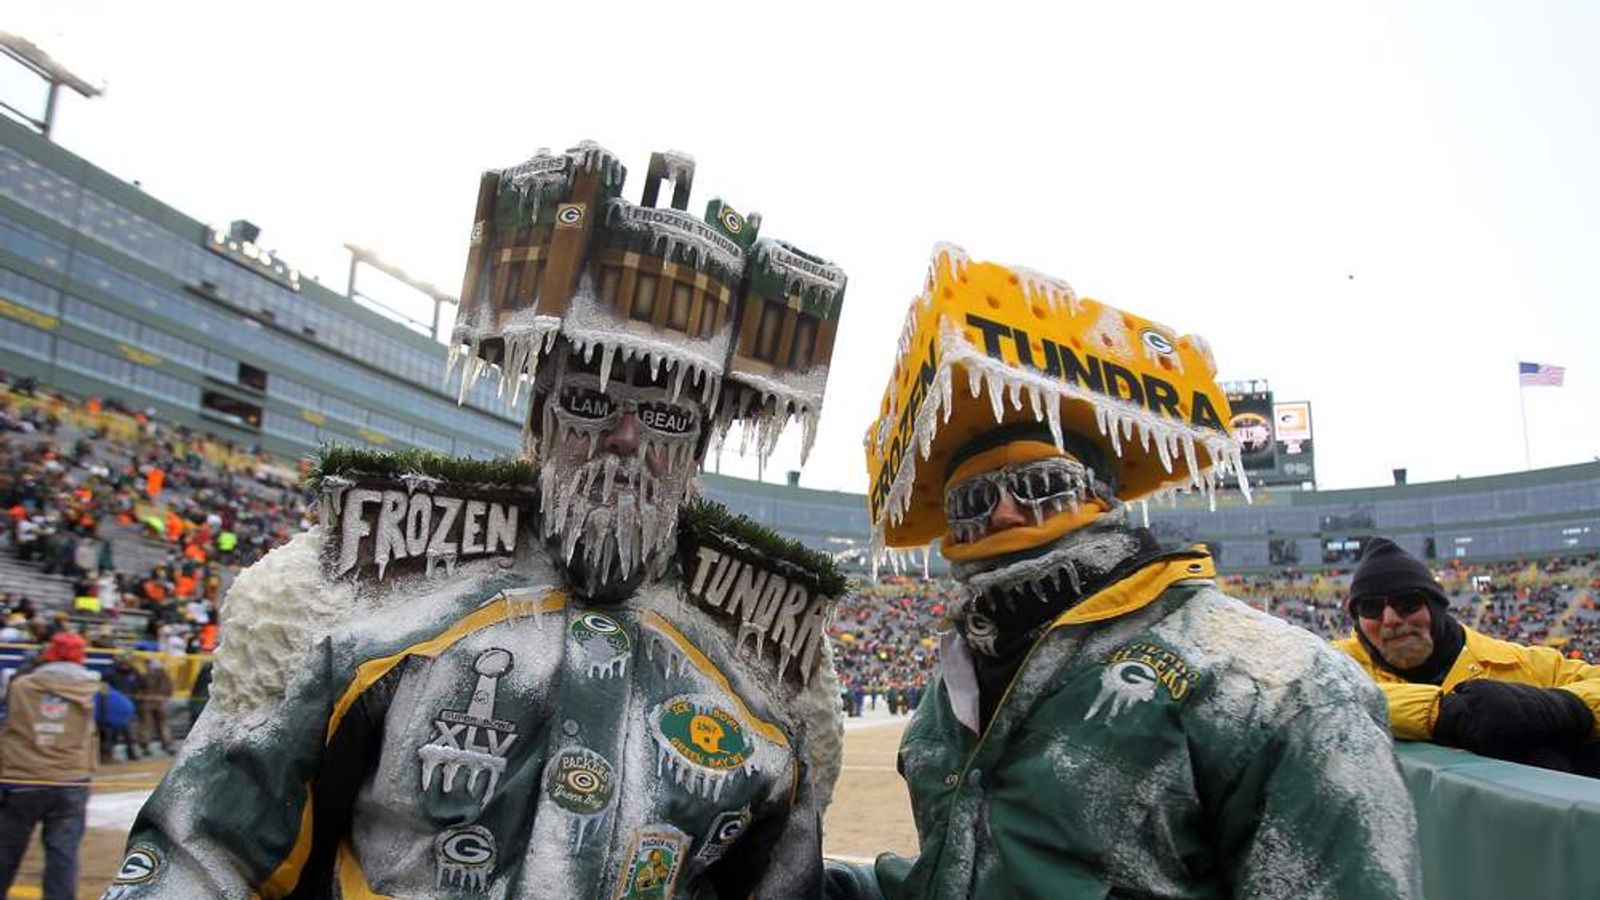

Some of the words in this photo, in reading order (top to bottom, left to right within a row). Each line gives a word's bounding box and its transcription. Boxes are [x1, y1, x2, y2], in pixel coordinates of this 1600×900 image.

[632, 208, 693, 233] FROZEN
[697, 225, 740, 258] TUNDRA
[776, 251, 837, 281] LAMBEAU
[965, 313, 1232, 436] TUNDRA
[570, 396, 609, 418] LAM
[642, 409, 688, 432] BEAU
[332, 488, 519, 580] FROZEN
[690, 546, 829, 683] TUNDRA
[432, 721, 518, 756] XLV
[562, 755, 611, 783] PACKERS
